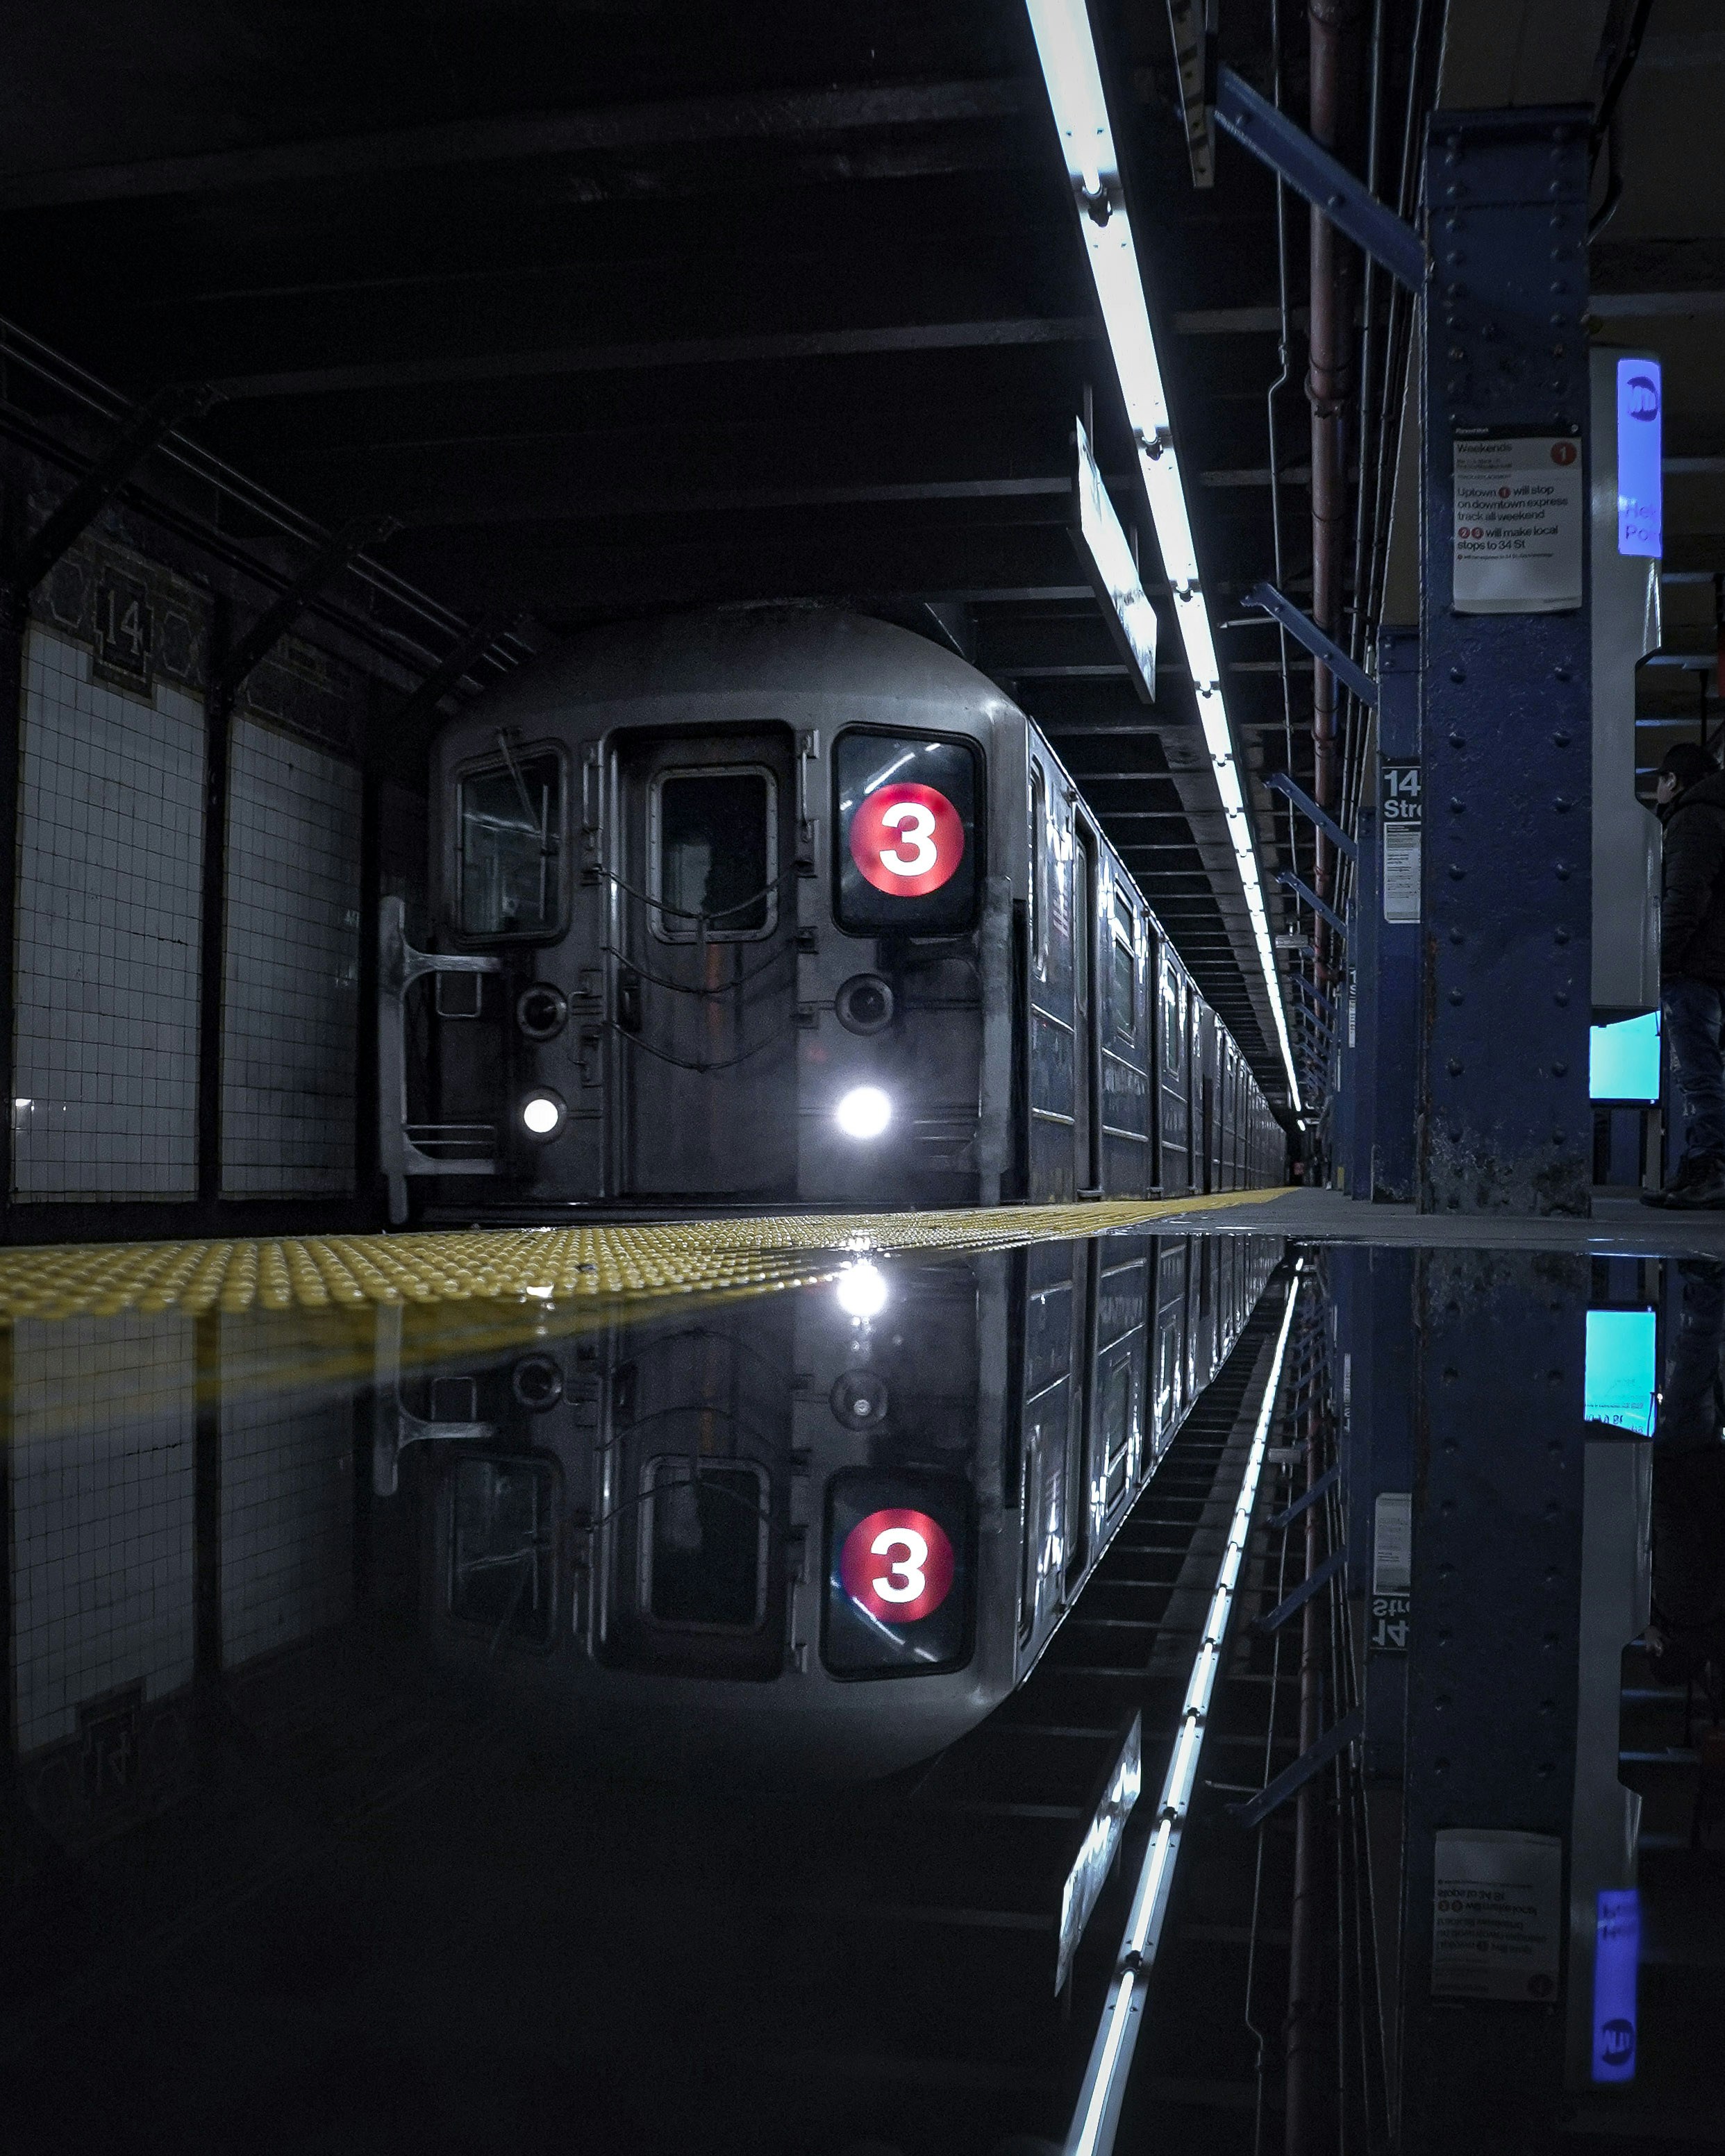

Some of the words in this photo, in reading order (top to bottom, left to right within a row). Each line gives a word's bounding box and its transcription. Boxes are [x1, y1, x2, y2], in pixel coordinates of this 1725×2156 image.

[1457, 443, 1512, 453] Weekends
[1458, 487, 1497, 499] Uptown
[1513, 486, 1530, 496] will
[1531, 485, 1554, 495] stop
[1472, 499, 1525, 509] downtown
[1526, 497, 1569, 508] express
[1458, 511, 1484, 521] track
[1485, 511, 1497, 521] all
[1498, 510, 1545, 520] weekend
[1485, 528, 1501, 537] will
[1503, 527, 1532, 537] make
[1533, 525, 1558, 535] local
[1458, 540, 1485, 551] stops
[1488, 540, 1497, 549] to
[1498, 540, 1512, 549] 34
[1513, 539, 1526, 549] St
[106, 590, 142, 656] 14
[1384, 770, 1422, 796] 14
[879, 802, 938, 876] 3
